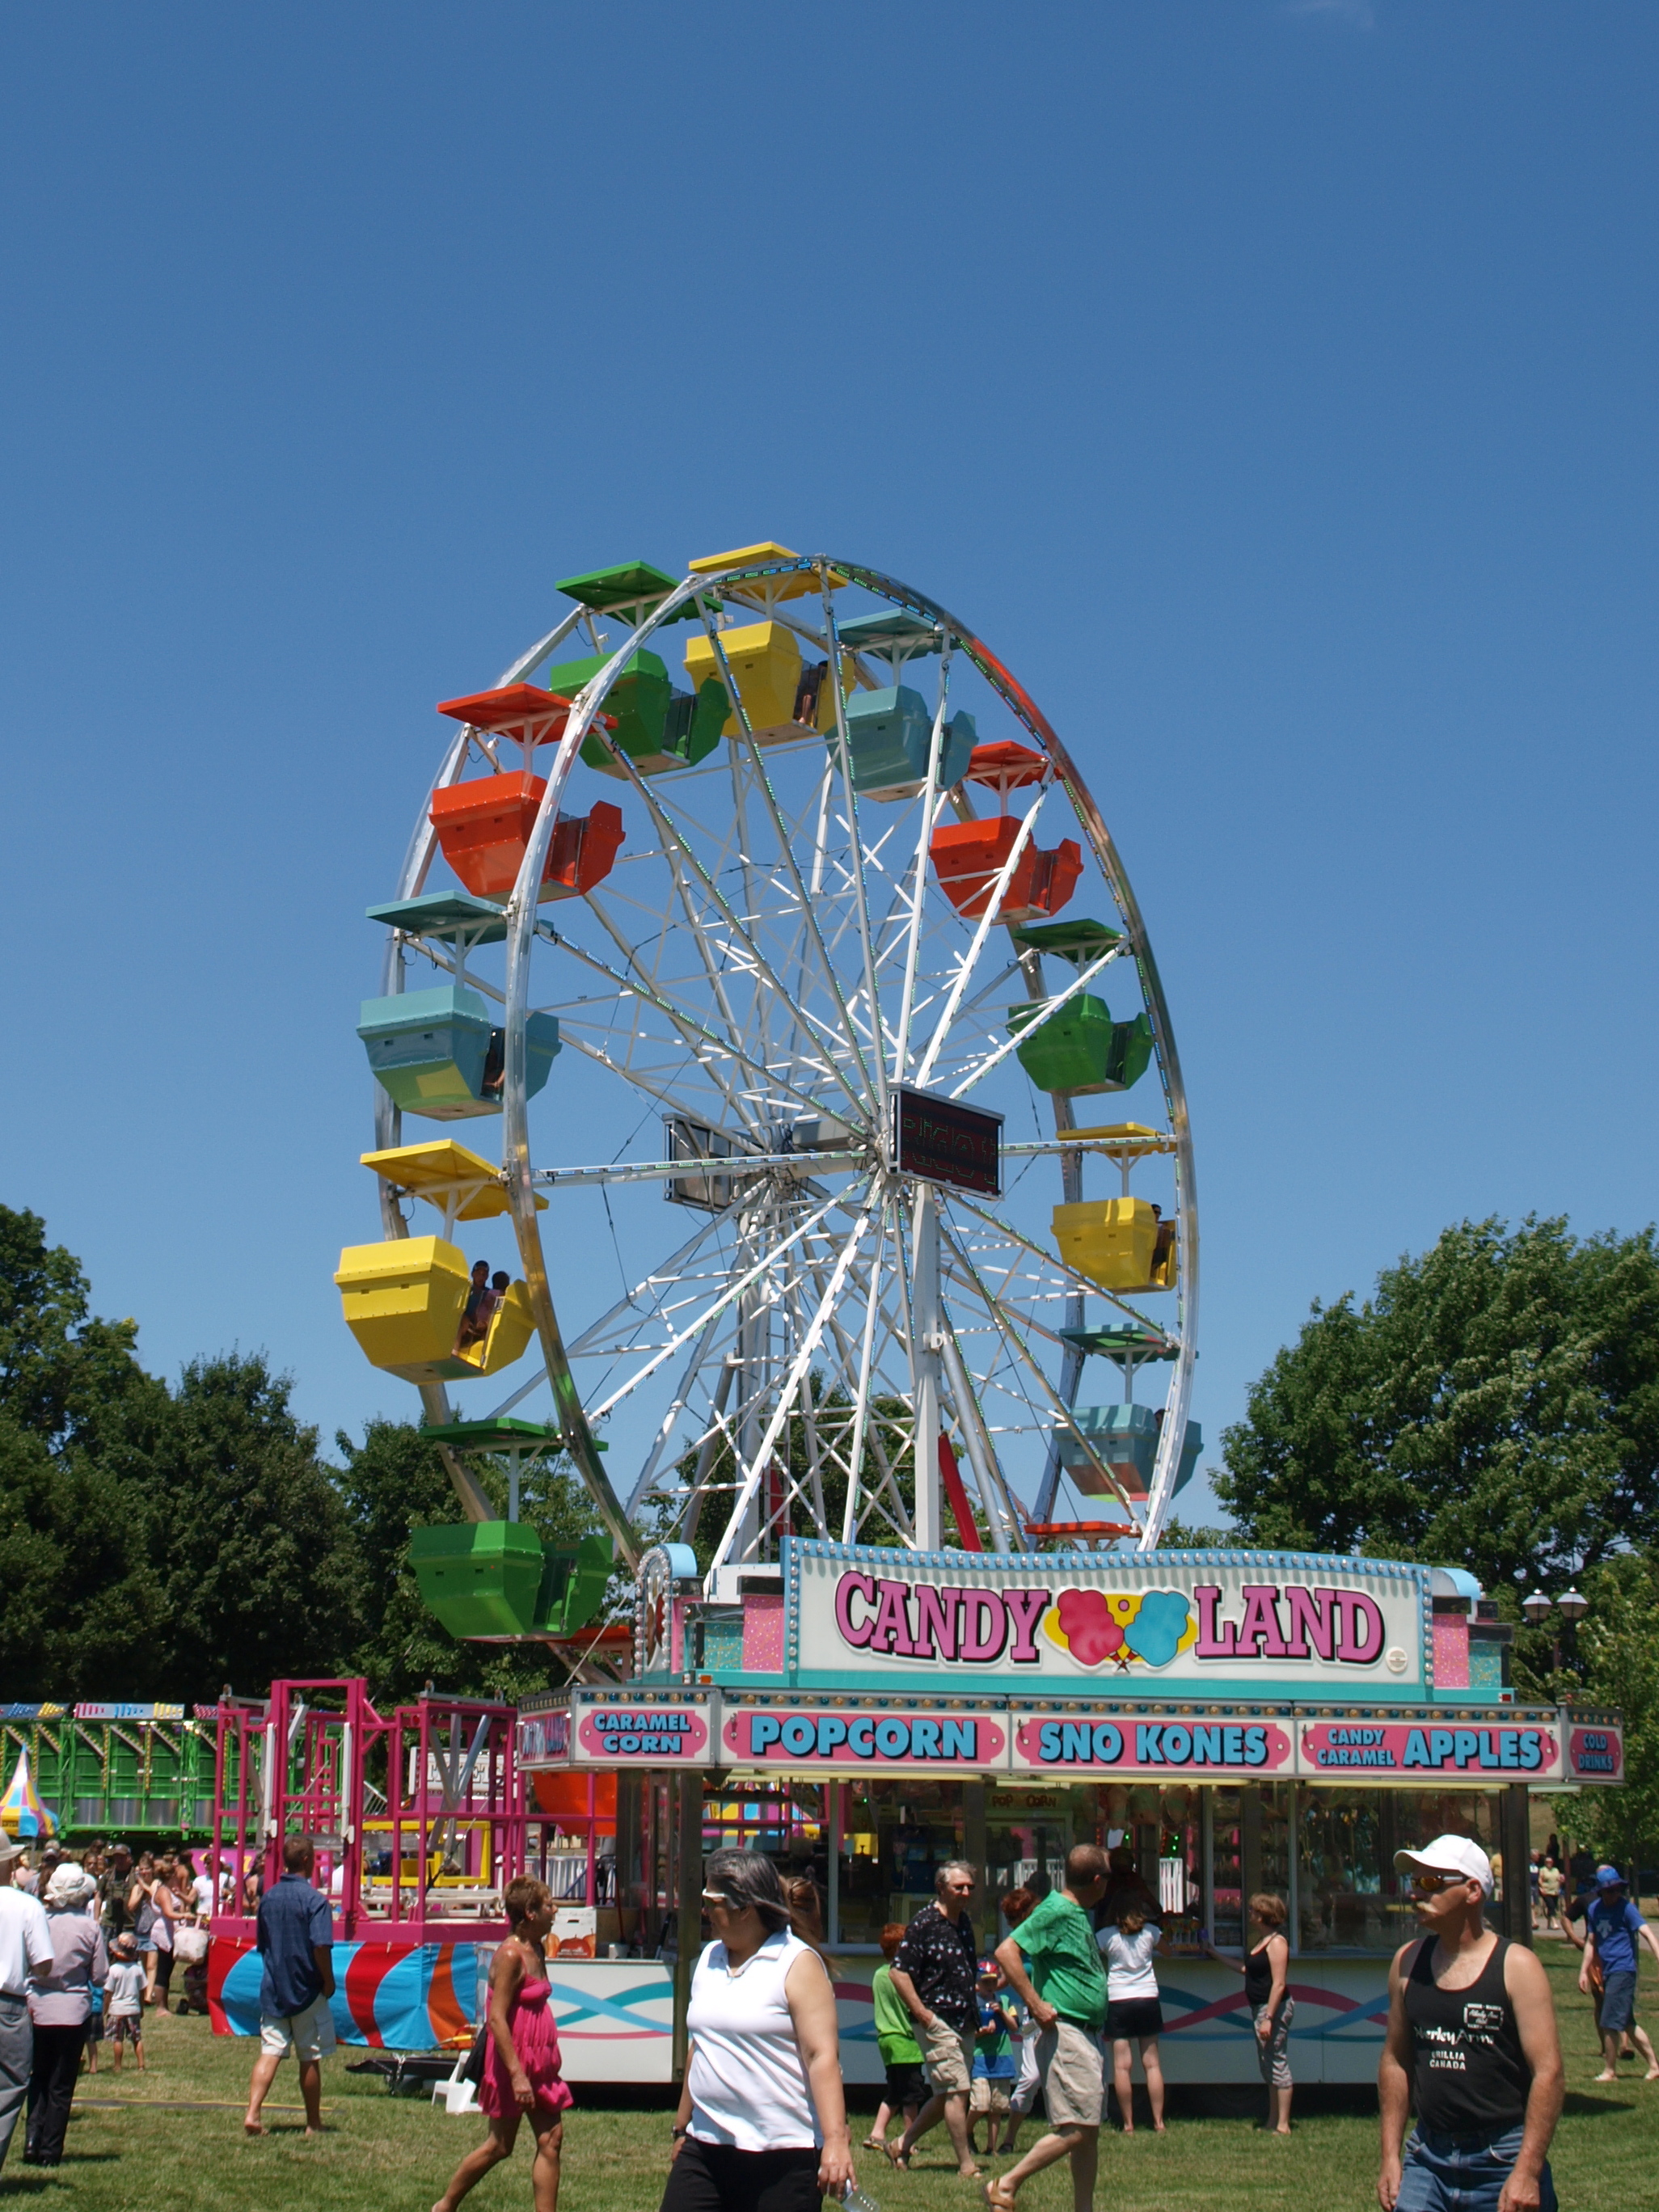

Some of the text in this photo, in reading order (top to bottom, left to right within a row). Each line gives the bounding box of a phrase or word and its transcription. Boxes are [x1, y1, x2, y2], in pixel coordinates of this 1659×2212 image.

[835, 1569, 1387, 1665] CANDY LAND
[593, 1711, 691, 1733] CARAMEL
[602, 1734, 682, 1754] CORN
[750, 1714, 978, 1760] POPCORN
[1038, 1721, 1269, 1767] SNO KONES
[1327, 1728, 1384, 1748] CANDY
[1582, 1733, 1607, 1751] COLD
[1317, 1747, 1396, 1768] CARAMEL
[1403, 1729, 1543, 1771] APPLES
[1578, 1754, 1614, 1772] DRINKS
[1429, 2059, 1466, 2071] CANADA
